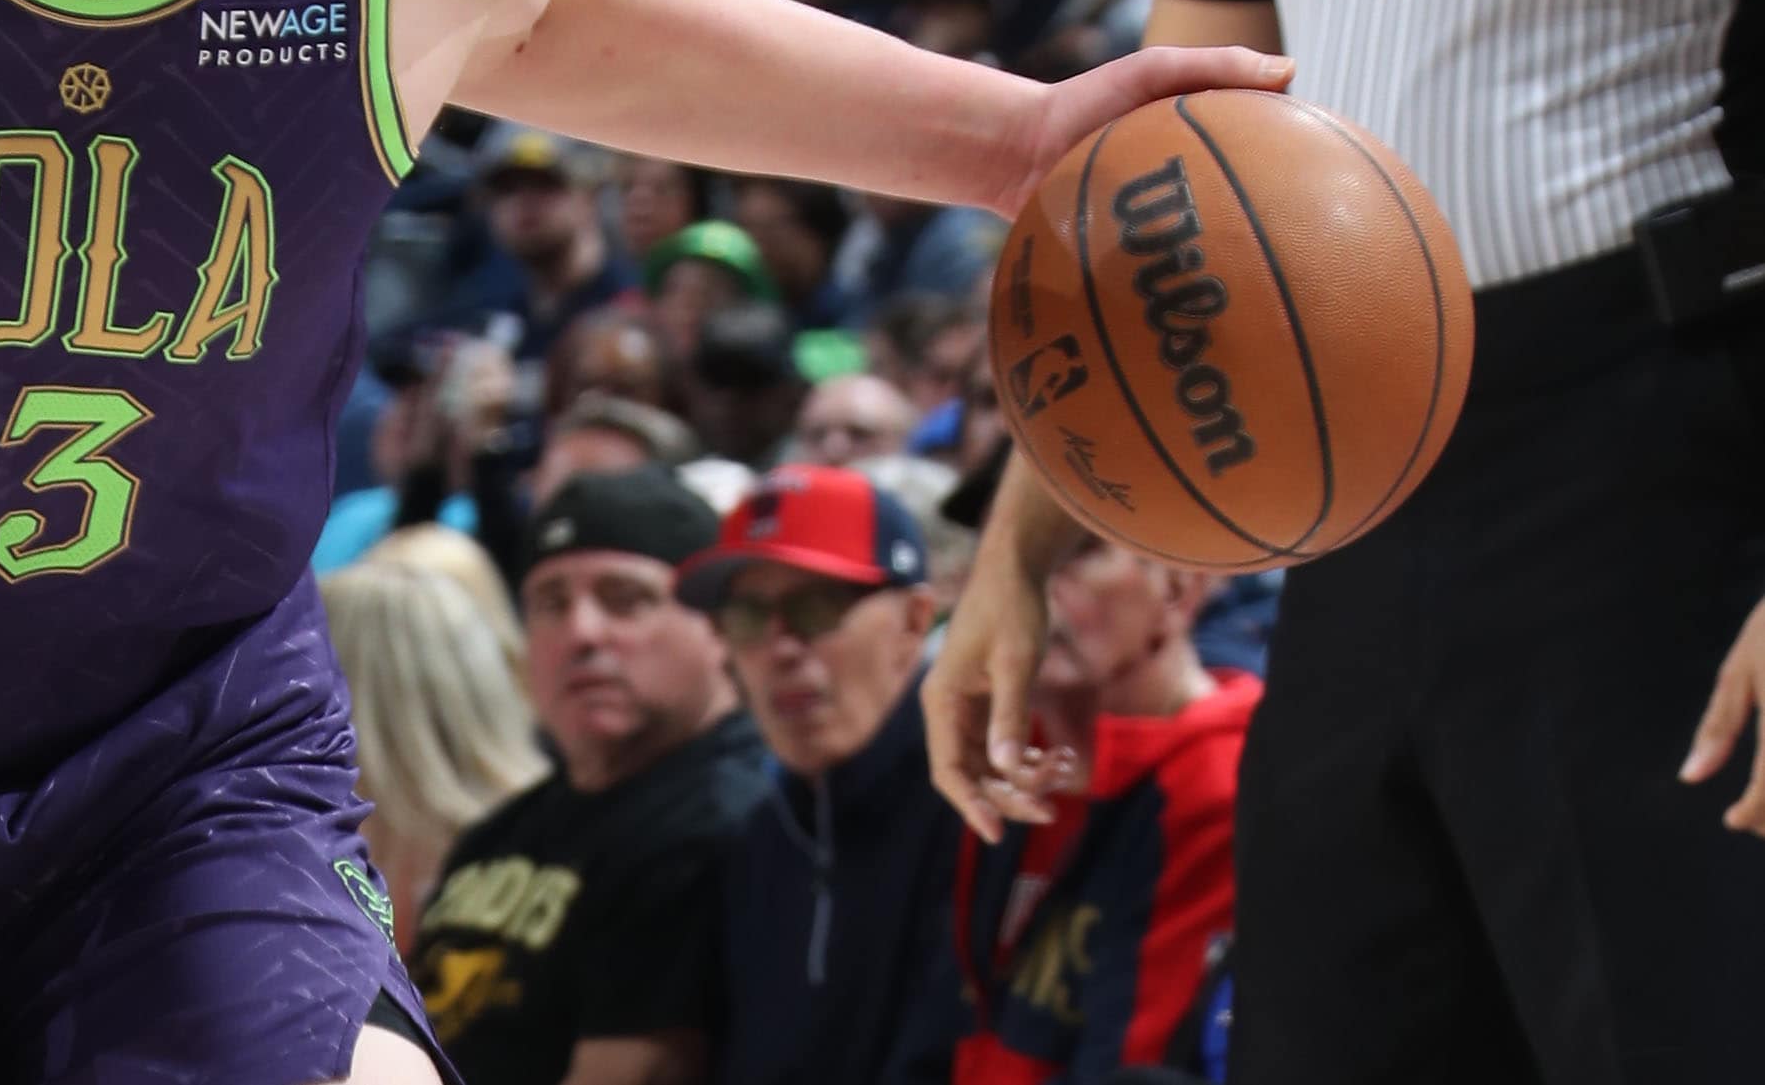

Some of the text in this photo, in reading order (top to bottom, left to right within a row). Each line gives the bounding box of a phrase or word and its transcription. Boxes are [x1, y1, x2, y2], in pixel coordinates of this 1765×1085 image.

[200, 2, 347, 41] NEWAGE
[198, 42, 347, 66] PRODUCTS
[1111, 154, 1257, 479] Wilson
